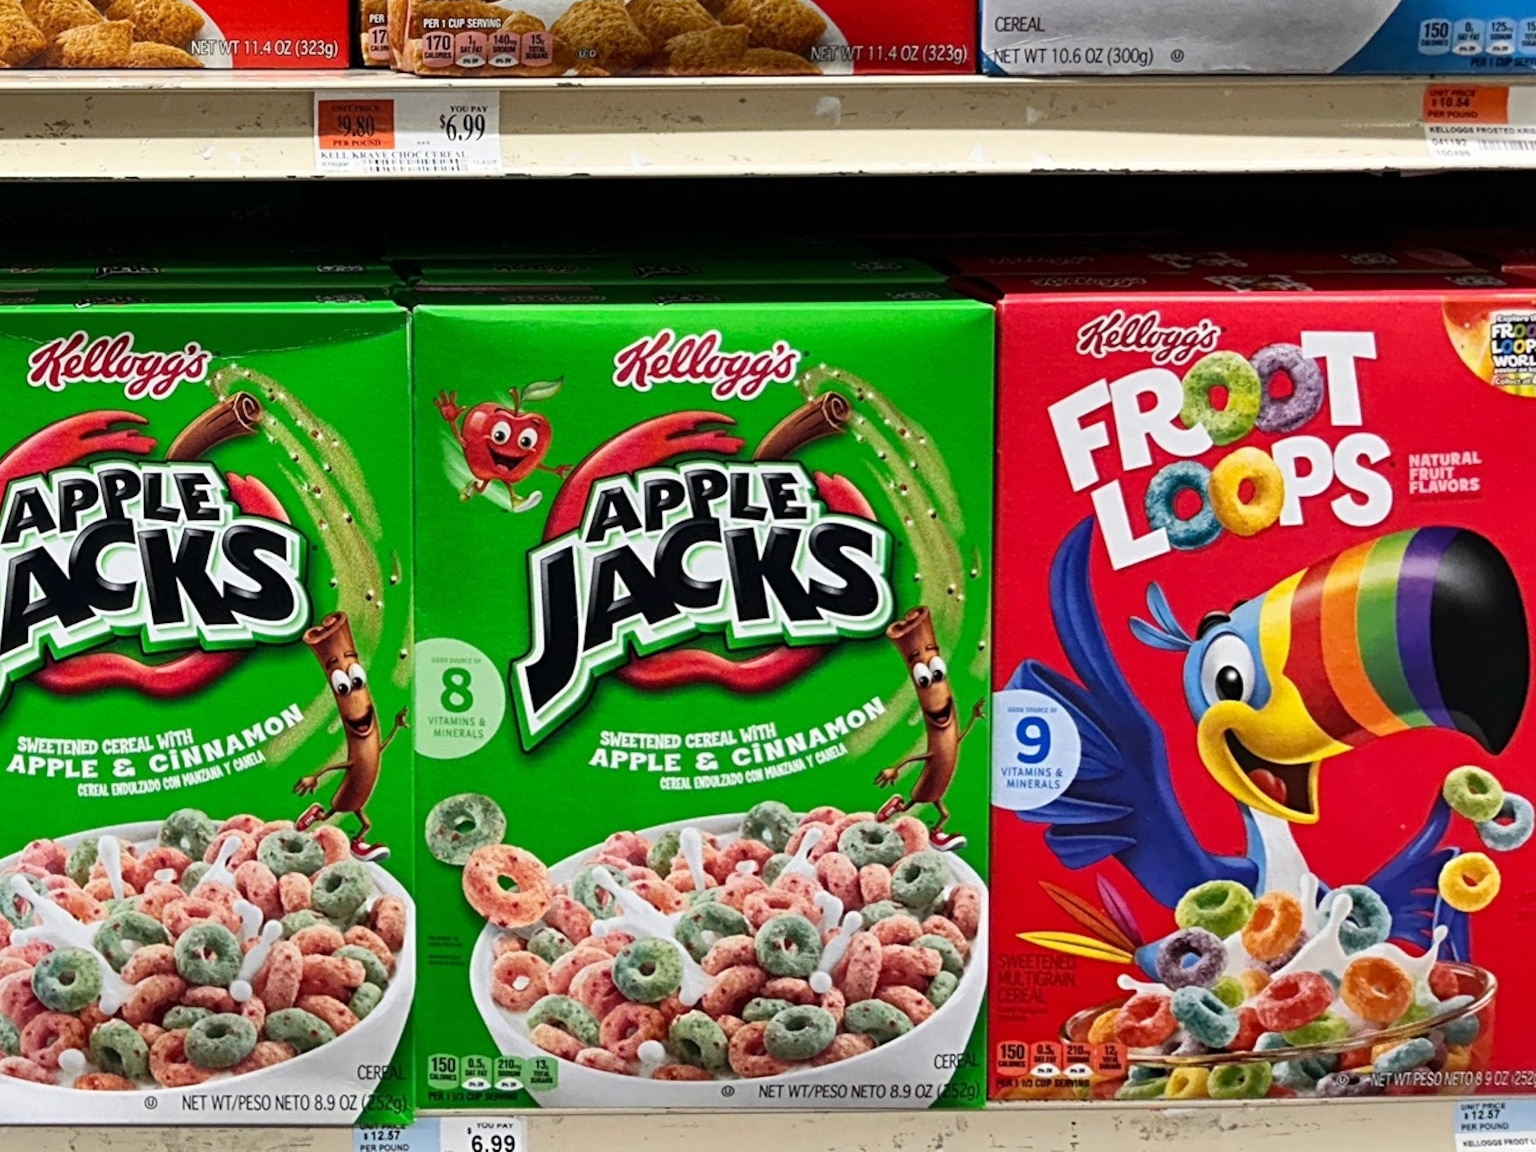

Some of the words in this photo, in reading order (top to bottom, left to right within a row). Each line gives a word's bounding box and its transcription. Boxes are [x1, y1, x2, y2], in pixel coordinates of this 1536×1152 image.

[994, 17, 1044, 32] CEREAL
[993, 48, 1018, 64] NET
[1020, 48, 1047, 64] WT
[1051, 48, 1081, 64] 10.6
[1084, 48, 1103, 64] OZ
[1106, 47, 1154, 66] (300g)
[1077, 310, 1222, 364] Kellogg's
[28, 333, 212, 399] Kellogg's
[613, 329, 801, 399] Kellogg's
[1048, 331, 1376, 492] FROOT
[1408, 451, 1482, 467] NATURAL
[1409, 467, 1455, 481] FRUIT
[2, 468, 220, 544] APPLE
[586, 469, 806, 543] APPLE
[1091, 432, 1392, 570] LOOPS
[1409, 478, 1481, 493] FLAVORS
[525, 519, 879, 715] JACKS
[439, 667, 474, 713] 8
[17, 737, 98, 754] SWEETENED
[102, 736, 153, 754] CEREAL
[1015, 716, 1051, 764] 9
[7, 754, 97, 778] APPLE
[182, 1095, 207, 1111] NET
[273, 1094, 310, 1111] NETO
[313, 1094, 337, 1110] 8.9
[340, 1094, 358, 1111] OZ
[362, 1094, 408, 1115] (252g)
